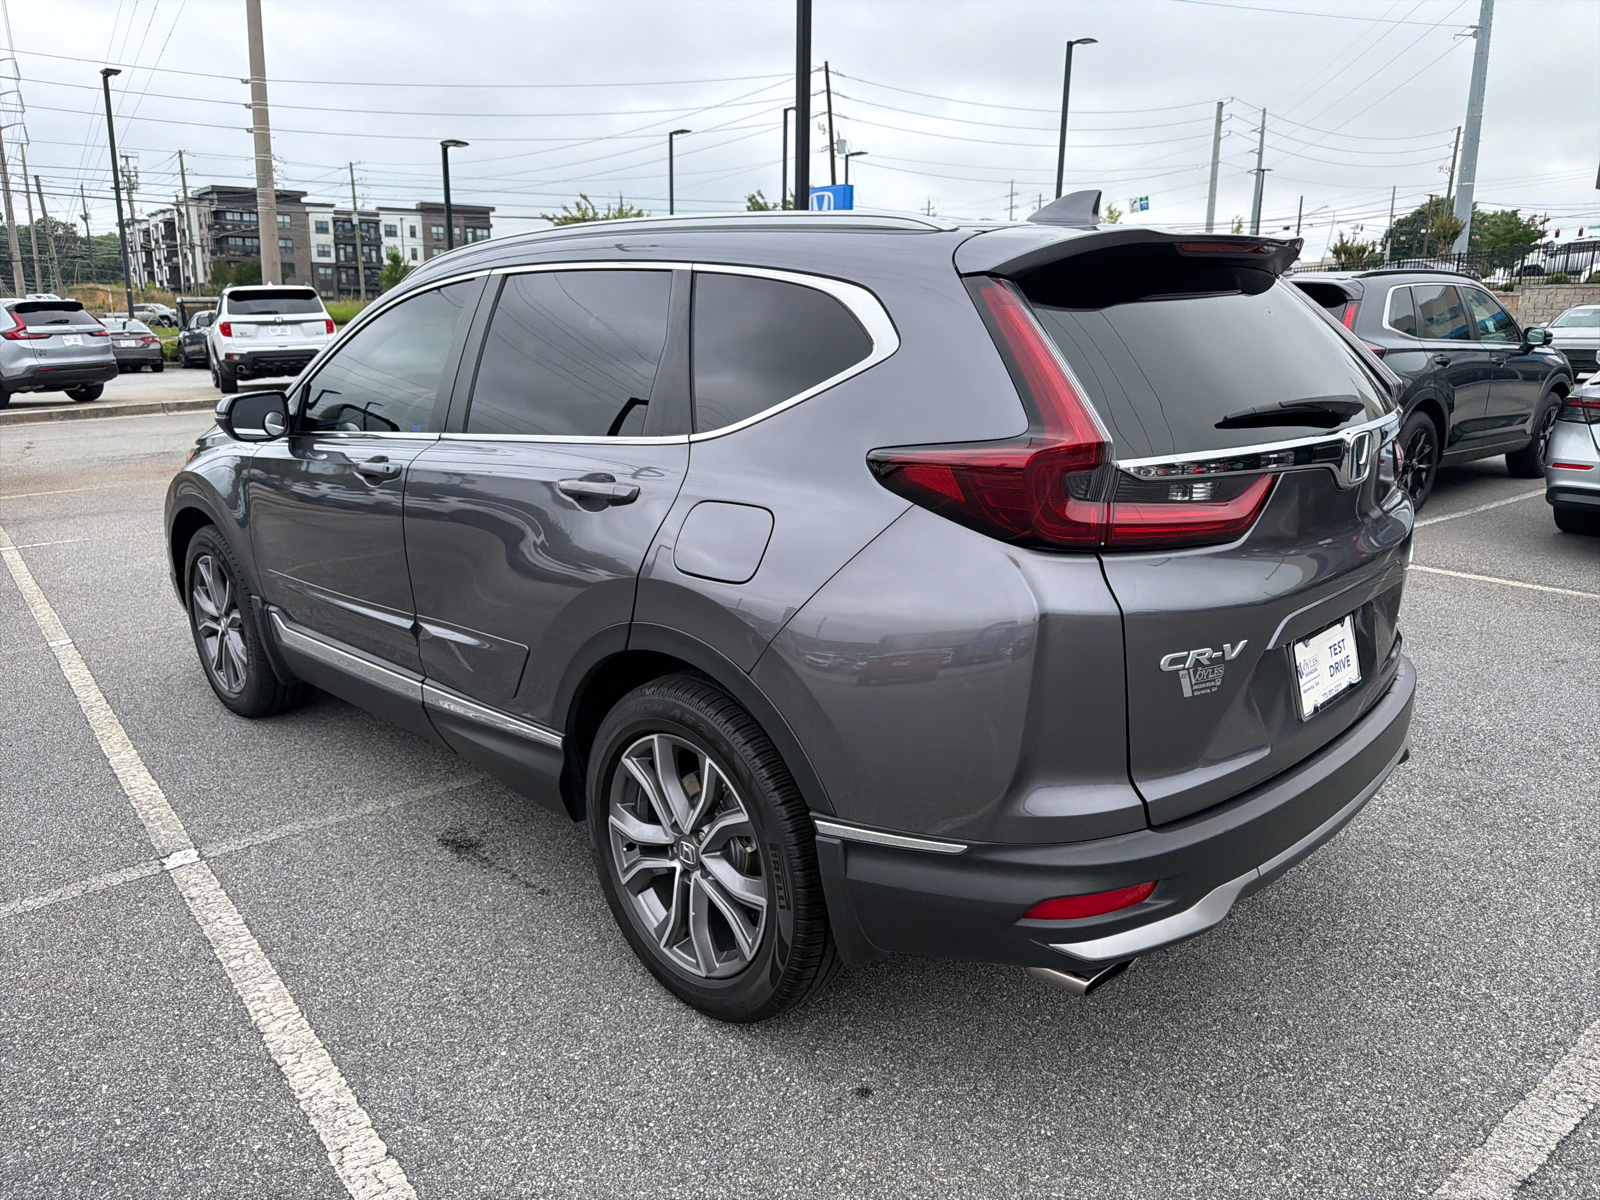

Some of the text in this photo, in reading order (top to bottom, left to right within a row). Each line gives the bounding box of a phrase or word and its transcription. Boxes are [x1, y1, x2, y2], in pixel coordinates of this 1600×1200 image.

[1160, 640, 1248, 671] CR-V
[1328, 638, 1346, 658] TEST
[1189, 665, 1224, 685] VOYLES
[1329, 655, 1351, 677] DRIVE
